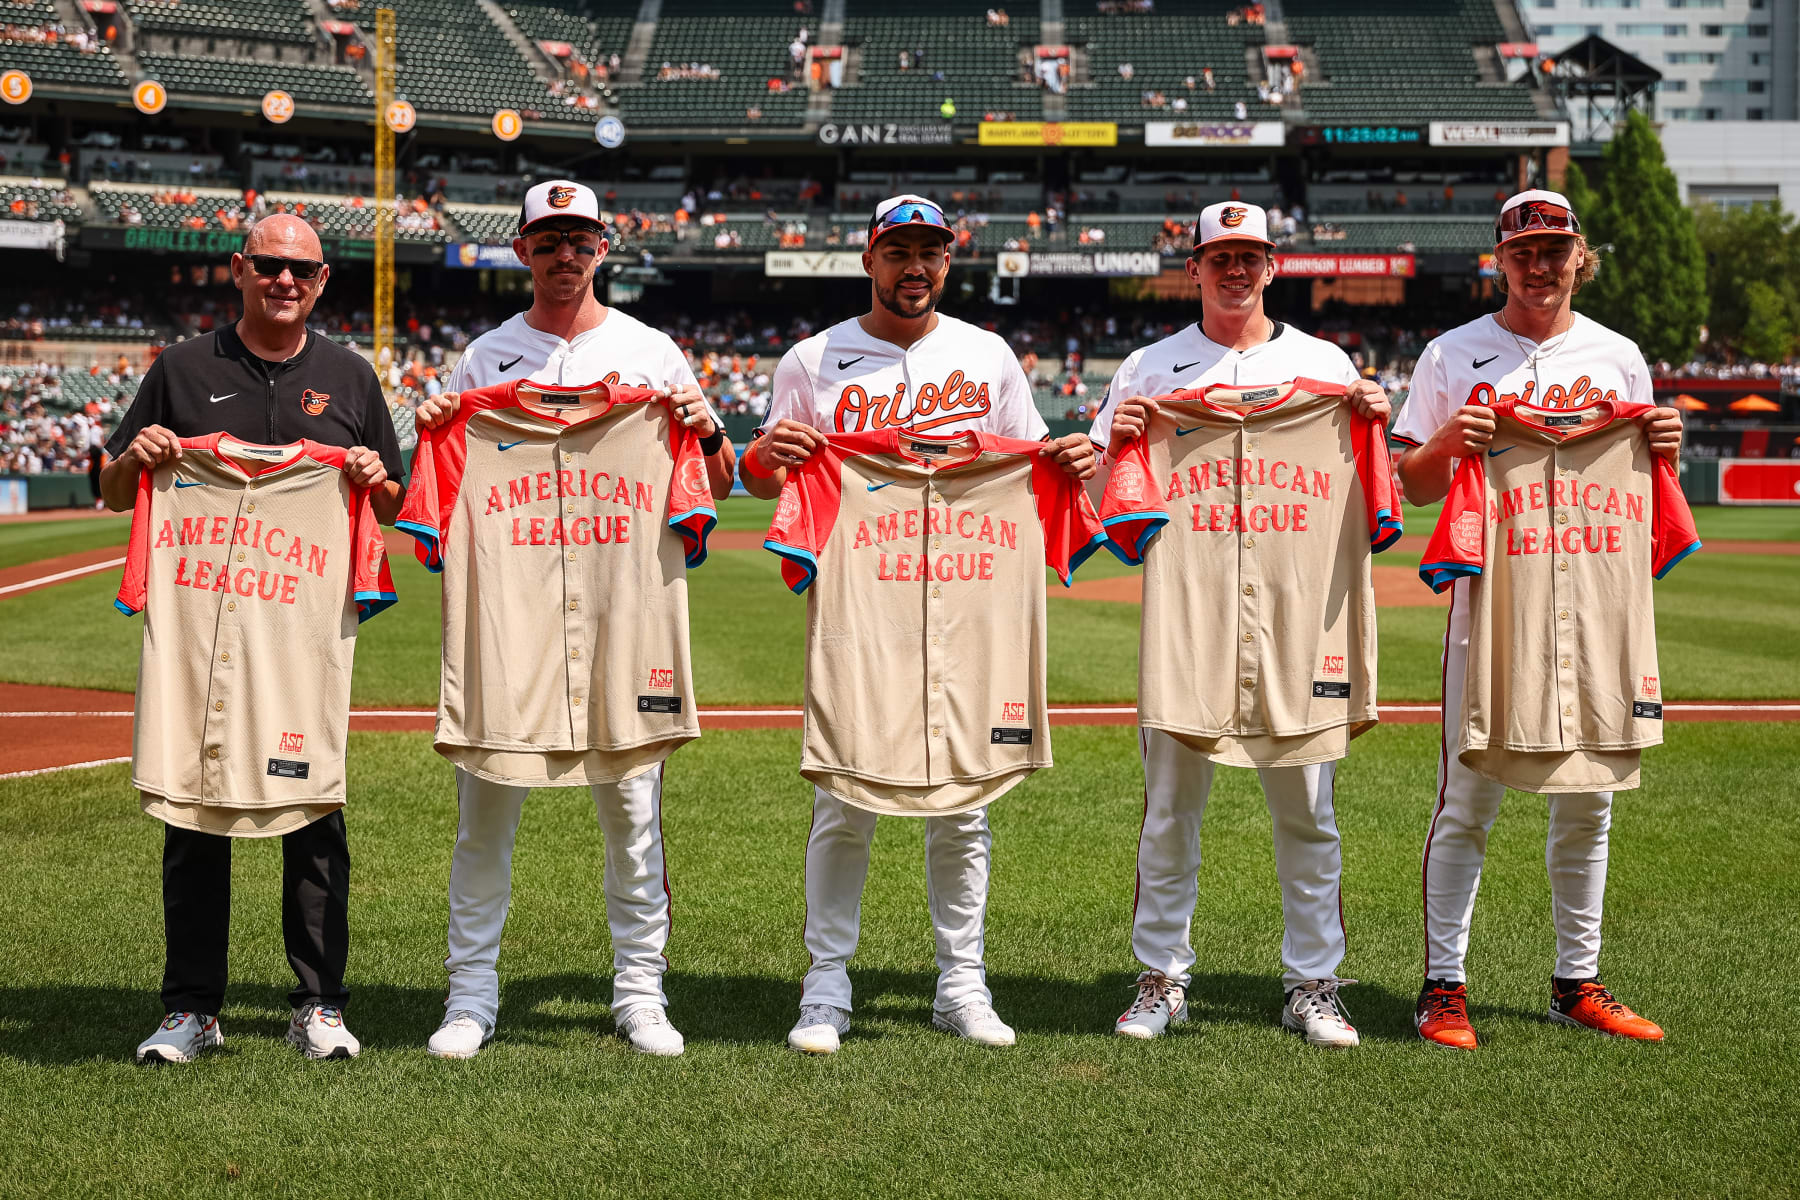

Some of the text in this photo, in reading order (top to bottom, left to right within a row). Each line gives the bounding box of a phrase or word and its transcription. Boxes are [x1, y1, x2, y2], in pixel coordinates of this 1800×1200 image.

[143, 88, 156, 106] 4
[819, 123, 898, 145] GANZ
[124, 228, 243, 252] ORIOLES.COM
[1094, 252, 1160, 274] UNION
[1281, 258, 1336, 273] JOHNSON
[1339, 259, 1386, 273] LUMBER
[834, 369, 991, 432] Orioles
[485, 469, 653, 515] AMERICAN
[1166, 458, 1331, 501] AMERICAN
[1489, 479, 1643, 527] AMERICAN
[511, 515, 630, 546] LEAGUE
[853, 507, 1017, 550] AMERICAN
[1191, 504, 1309, 532] LEAGUE
[154, 516, 328, 577] AMERICAN
[1507, 526, 1622, 556] LEAGUE
[174, 557, 299, 604] LEAGUE
[878, 553, 994, 582] LEAGUE
[648, 668, 673, 688] ASG
[1322, 656, 1344, 674] ASG
[1001, 702, 1025, 721] ASG
[279, 732, 304, 752] ASG
